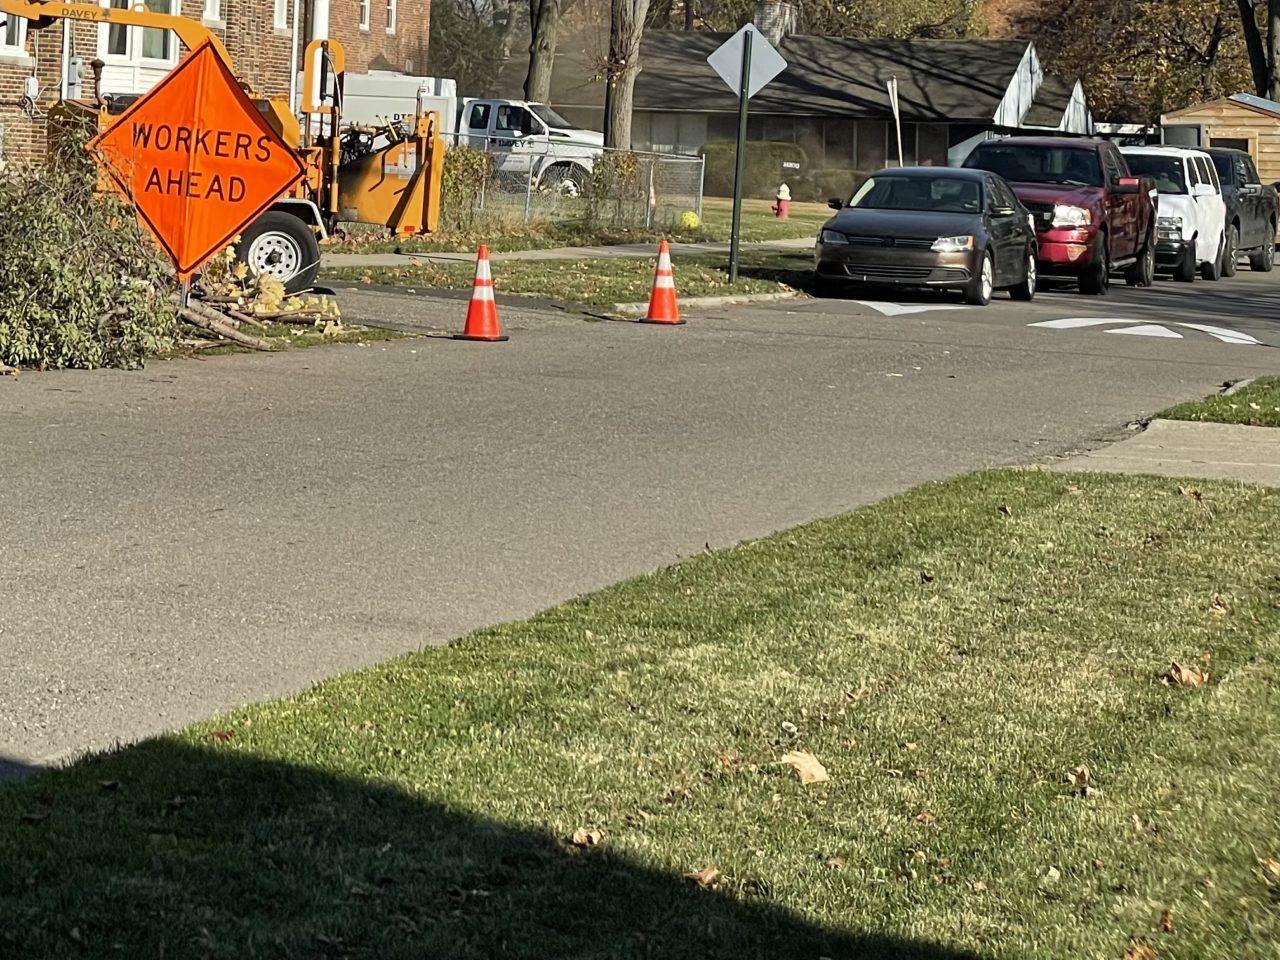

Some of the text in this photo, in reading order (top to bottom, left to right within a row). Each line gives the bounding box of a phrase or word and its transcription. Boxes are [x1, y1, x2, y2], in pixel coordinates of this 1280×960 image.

[61, 8, 98, 19] DAVEY
[132, 122, 271, 162] WORKERS
[144, 167, 247, 203] AHEAD
